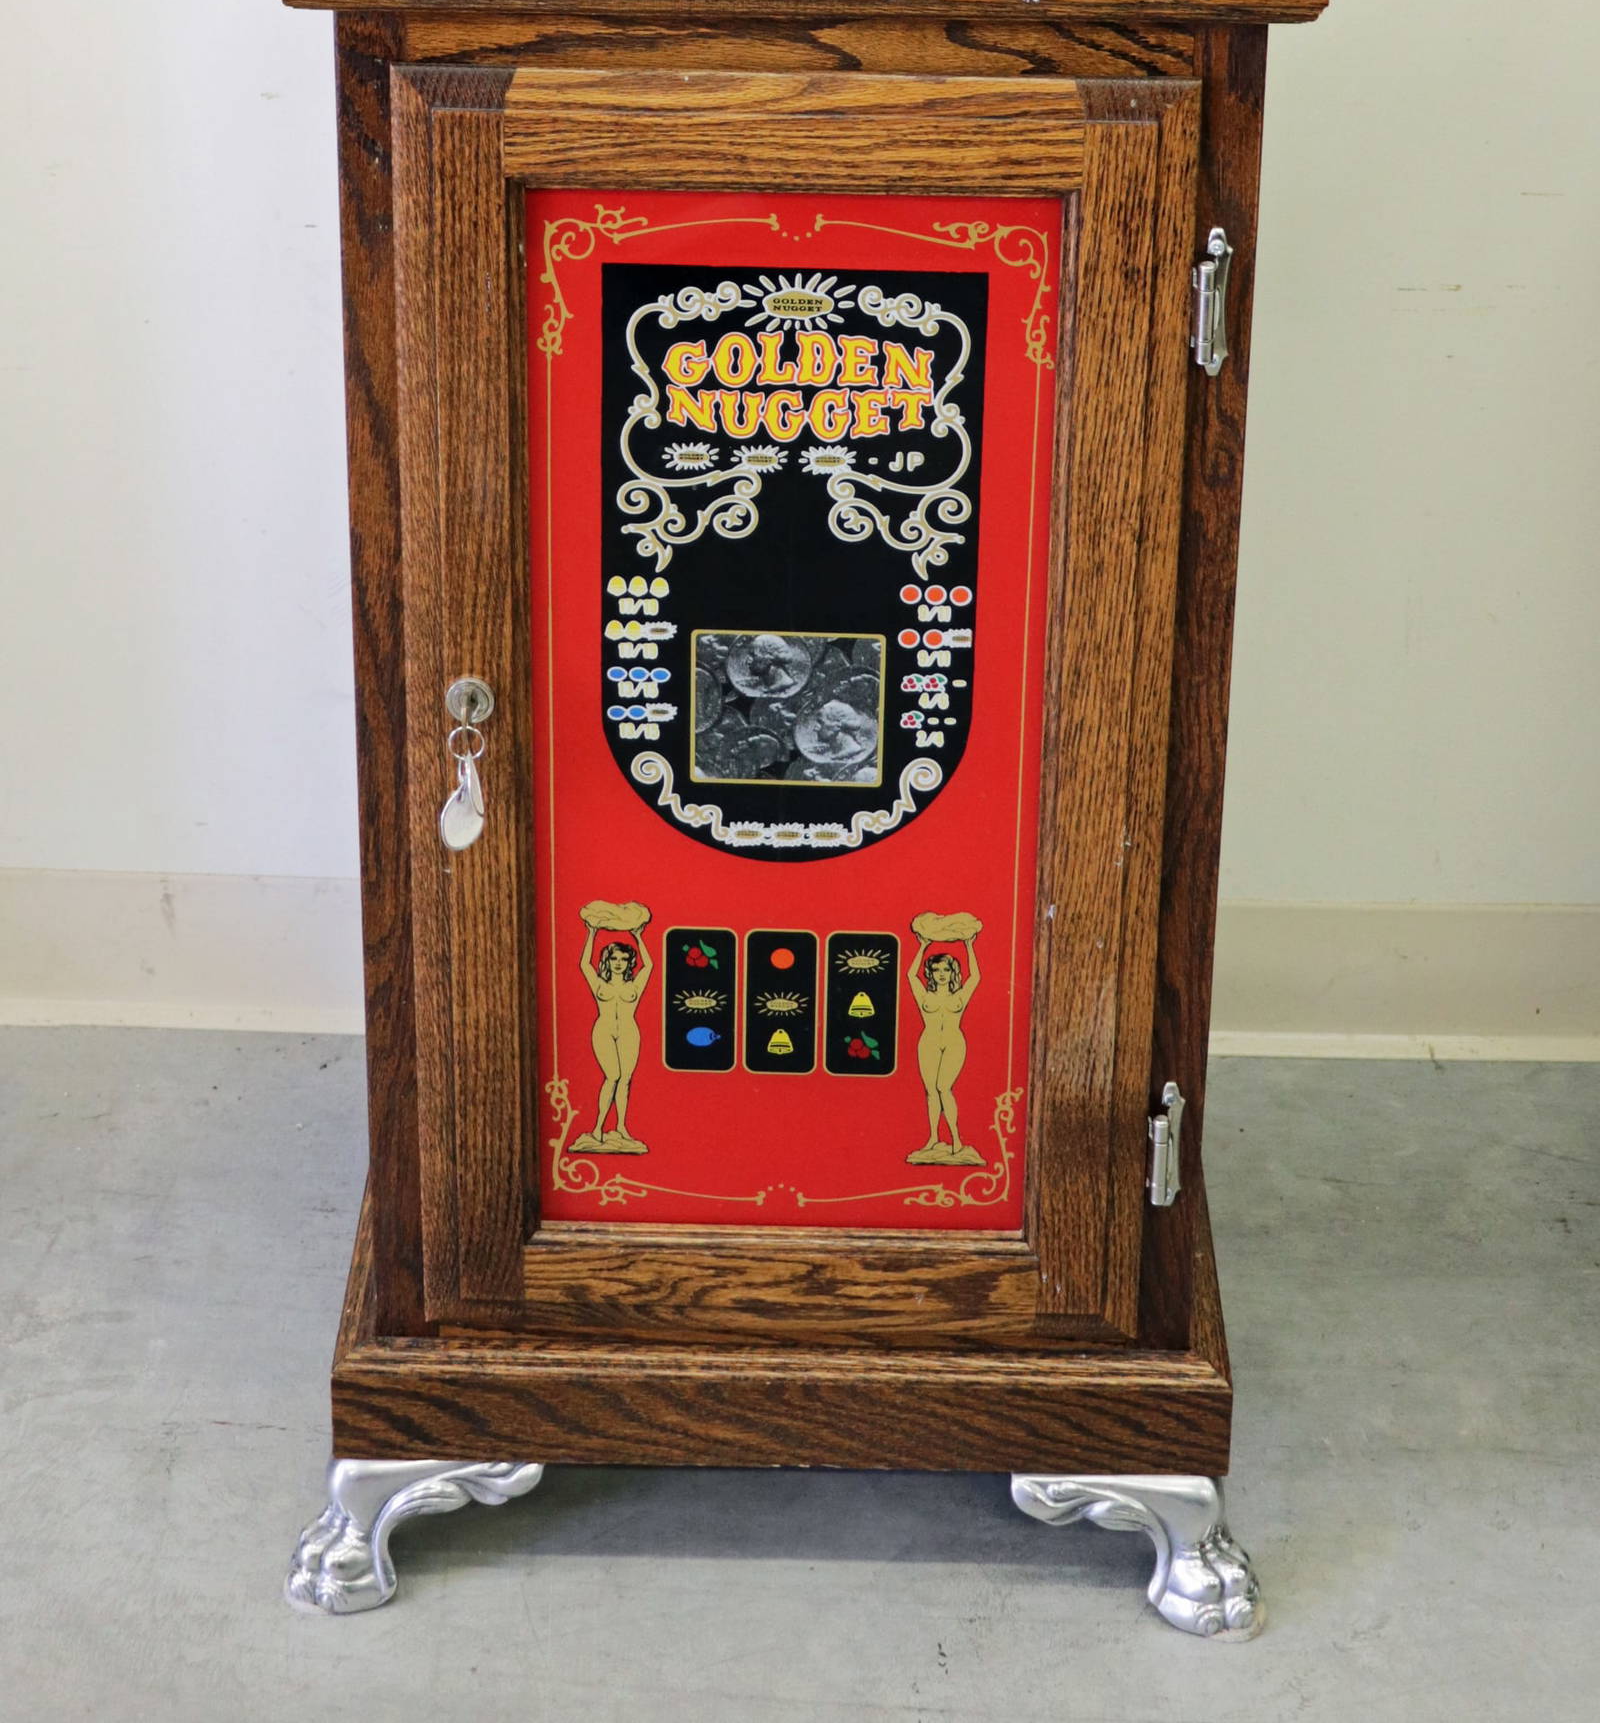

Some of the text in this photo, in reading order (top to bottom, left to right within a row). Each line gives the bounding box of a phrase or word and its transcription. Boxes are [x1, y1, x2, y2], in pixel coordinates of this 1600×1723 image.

[661, 331, 934, 389] GOLDEN
[666, 384, 933, 442] NUGGET
[888, 451, 924, 472] JP
